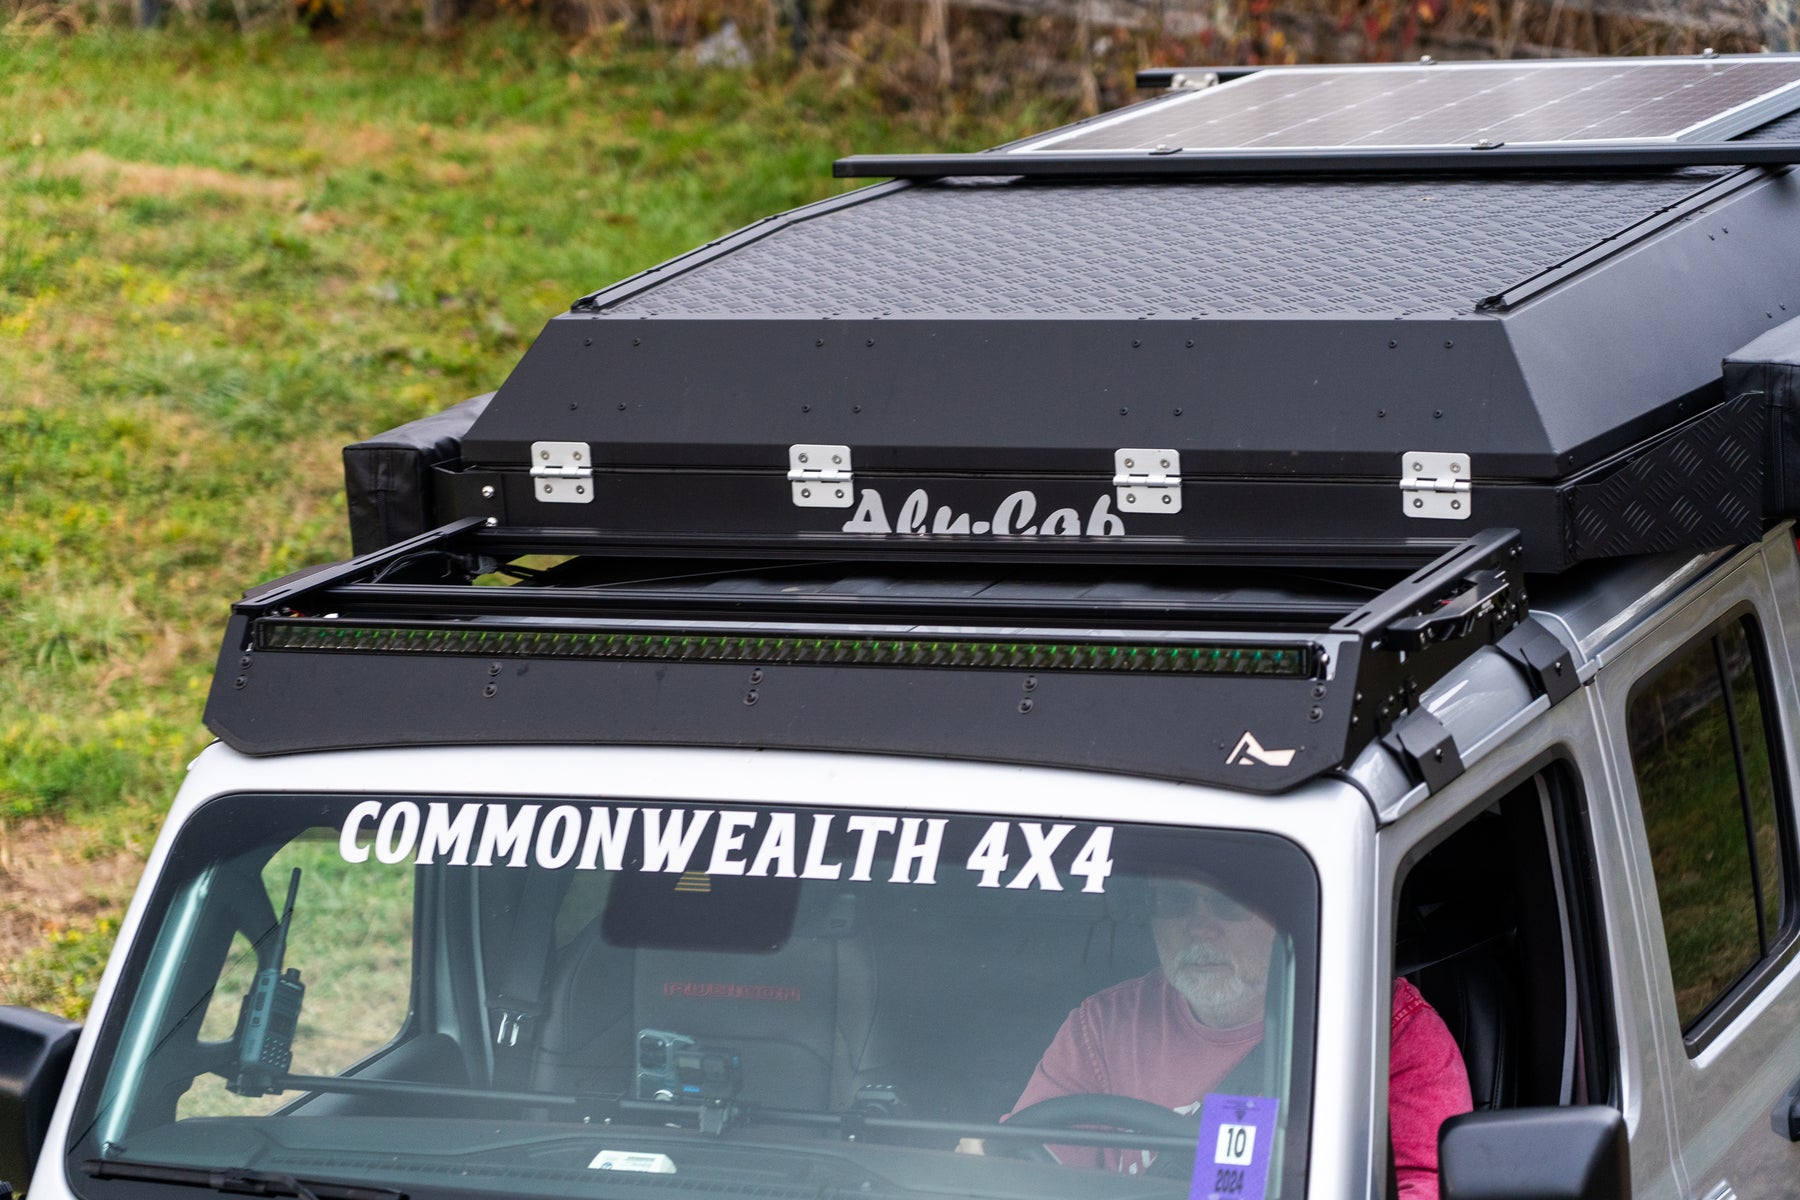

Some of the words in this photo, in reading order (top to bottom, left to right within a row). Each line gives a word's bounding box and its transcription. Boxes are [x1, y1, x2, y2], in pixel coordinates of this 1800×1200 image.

[338, 800, 948, 885] COMMONWEALTH
[966, 822, 1115, 894] 4X4
[1226, 1127, 1247, 1158] 10
[1214, 1168, 1245, 1193] 2024
